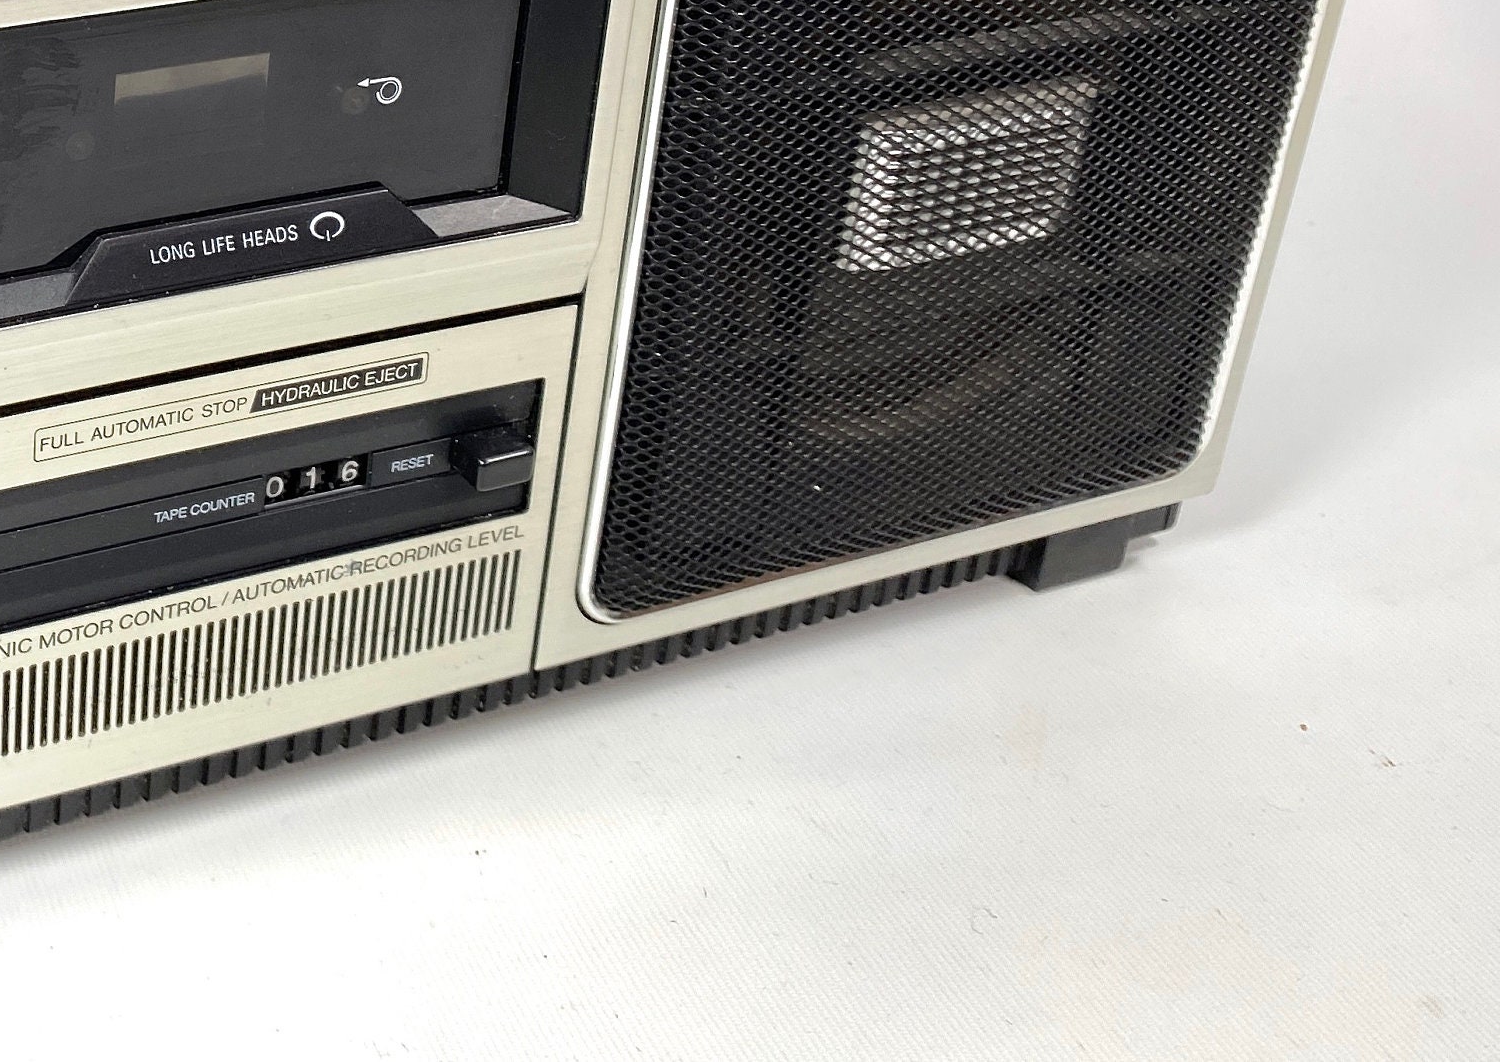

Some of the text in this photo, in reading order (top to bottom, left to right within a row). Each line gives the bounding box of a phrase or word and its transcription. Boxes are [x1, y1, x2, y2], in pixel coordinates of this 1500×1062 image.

[150, 224, 299, 266] LONG LIFE HEADS
[260, 361, 418, 408] HYDRAULIC EJECT
[38, 396, 248, 454] FULL AUTOMATIC STOP
[391, 454, 433, 474] RESET
[153, 491, 256, 524] TAPE COUNTER
[37, 617, 114, 650] MOTOR
[119, 595, 218, 632] CONTROL
[232, 566, 348, 605] AUTOMATIC
[348, 537, 463, 578] RECORDING
[467, 525, 525, 549] LEVEL
